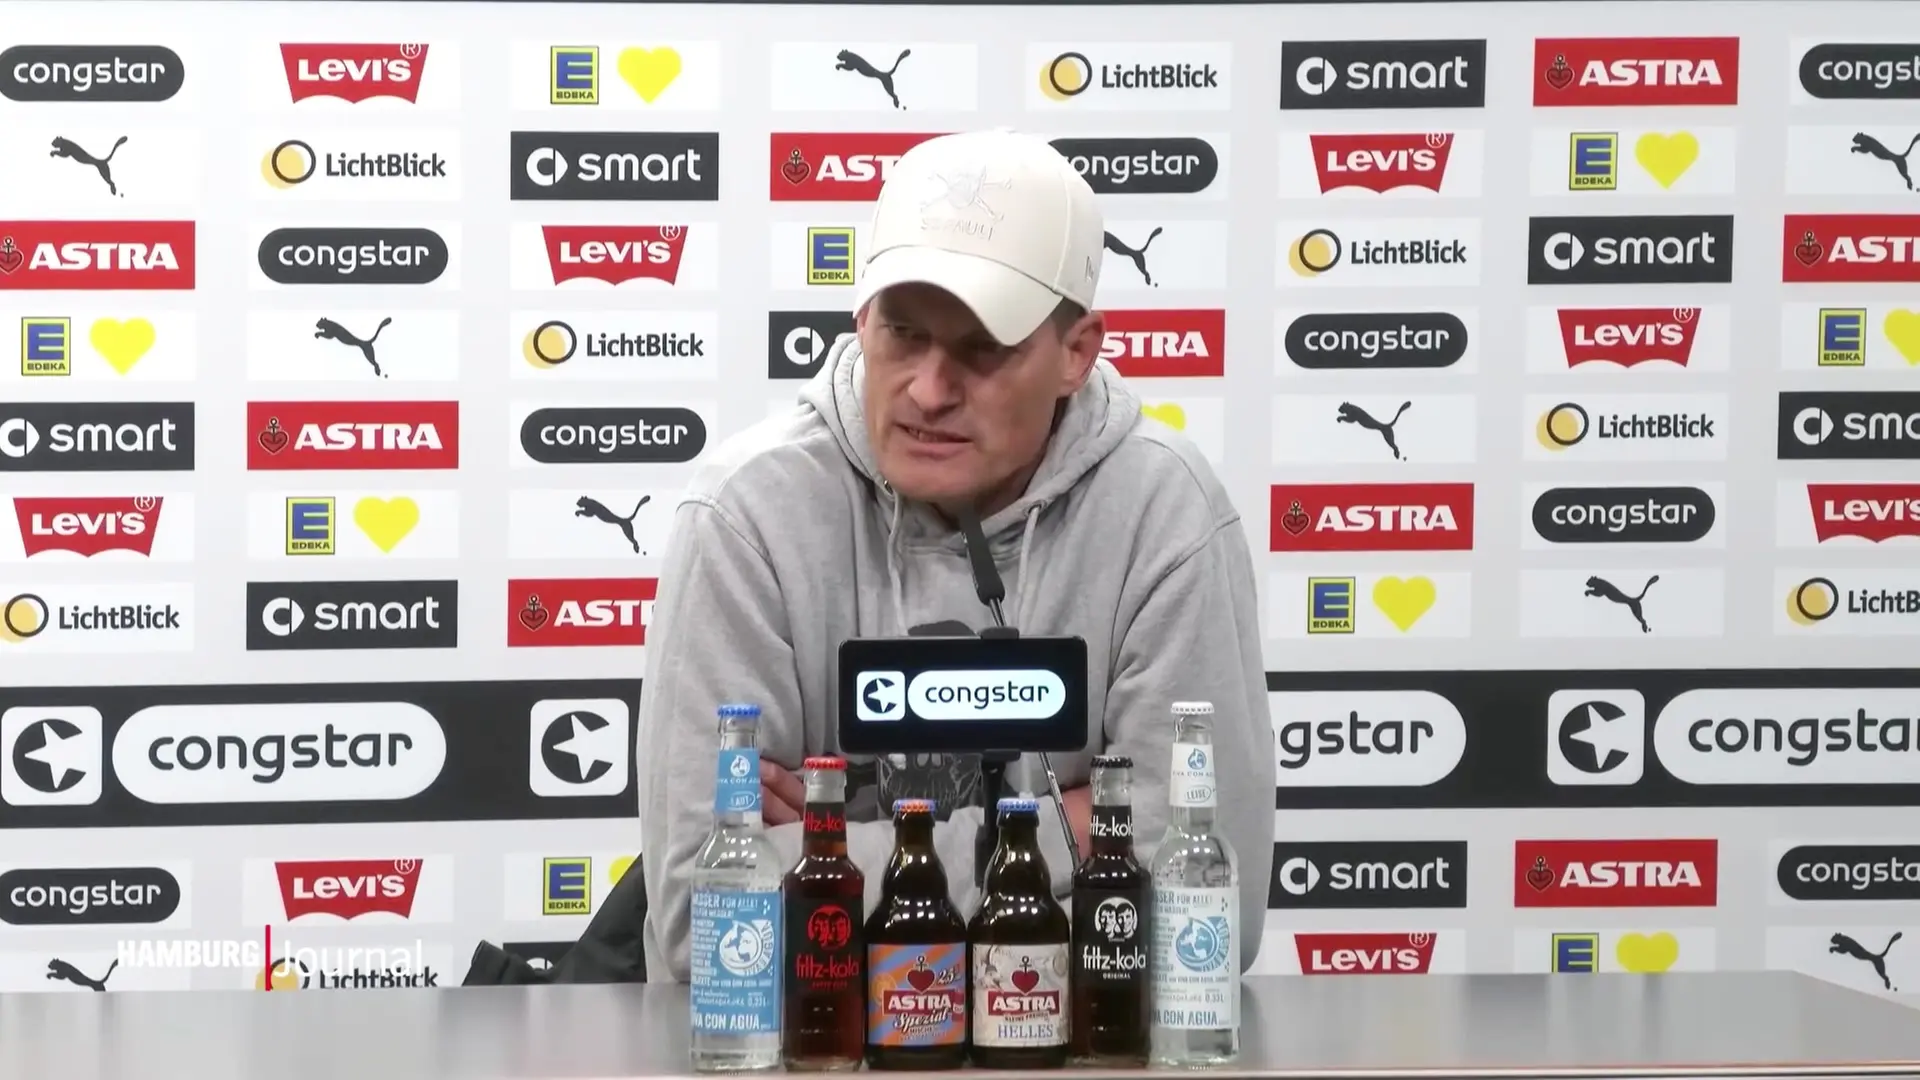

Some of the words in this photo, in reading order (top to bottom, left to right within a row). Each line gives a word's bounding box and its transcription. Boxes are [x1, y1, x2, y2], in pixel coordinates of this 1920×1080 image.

[14, 57, 165, 91] congstar
[1102, 64, 1217, 88] LichtBlick
[1347, 56, 1467, 89] smart
[1580, 60, 1722, 86] ASTRA
[327, 153, 445, 177] LichtBlick
[578, 149, 700, 181] smart
[1067, 150, 1199, 183] ongstar
[29, 243, 179, 269] ASTRA
[279, 240, 429, 273] congstar
[1351, 240, 1466, 264] LichtBlick
[1594, 232, 1714, 264] smart
[1828, 237, 1920, 262] AST
[587, 333, 703, 357] LichtBlick
[1305, 325, 1449, 358] congstar
[50, 419, 176, 452] smart
[295, 423, 442, 450] ASTRA
[541, 419, 687, 453] congstar
[1599, 414, 1714, 438] LichtBlick
[1316, 506, 1457, 531] ASTRA
[1552, 499, 1696, 532] congstar
[315, 597, 439, 630] smart
[1849, 590, 1920, 613] LichtB
[60, 605, 179, 629] LichtBlick
[925, 681, 1049, 709] congstar
[1272, 711, 1433, 769] gstar
[1689, 708, 1920, 766] congsta
[149, 724, 412, 783] congstar
[1330, 858, 1449, 889] smart
[1560, 862, 1701, 887] ASTRA
[11, 880, 161, 914] congstar
[1083, 944, 1146, 970] fritz-kola
[888, 994, 951, 1010] ASTRA
[992, 995, 1056, 1011] ASTRA
[704, 1012, 727, 1029] CON
[729, 1013, 760, 1030] AGUA
[998, 1023, 1054, 1039] HELLES
[1163, 1009, 1184, 1026] CON
[1187, 1010, 1217, 1027] AGUA
